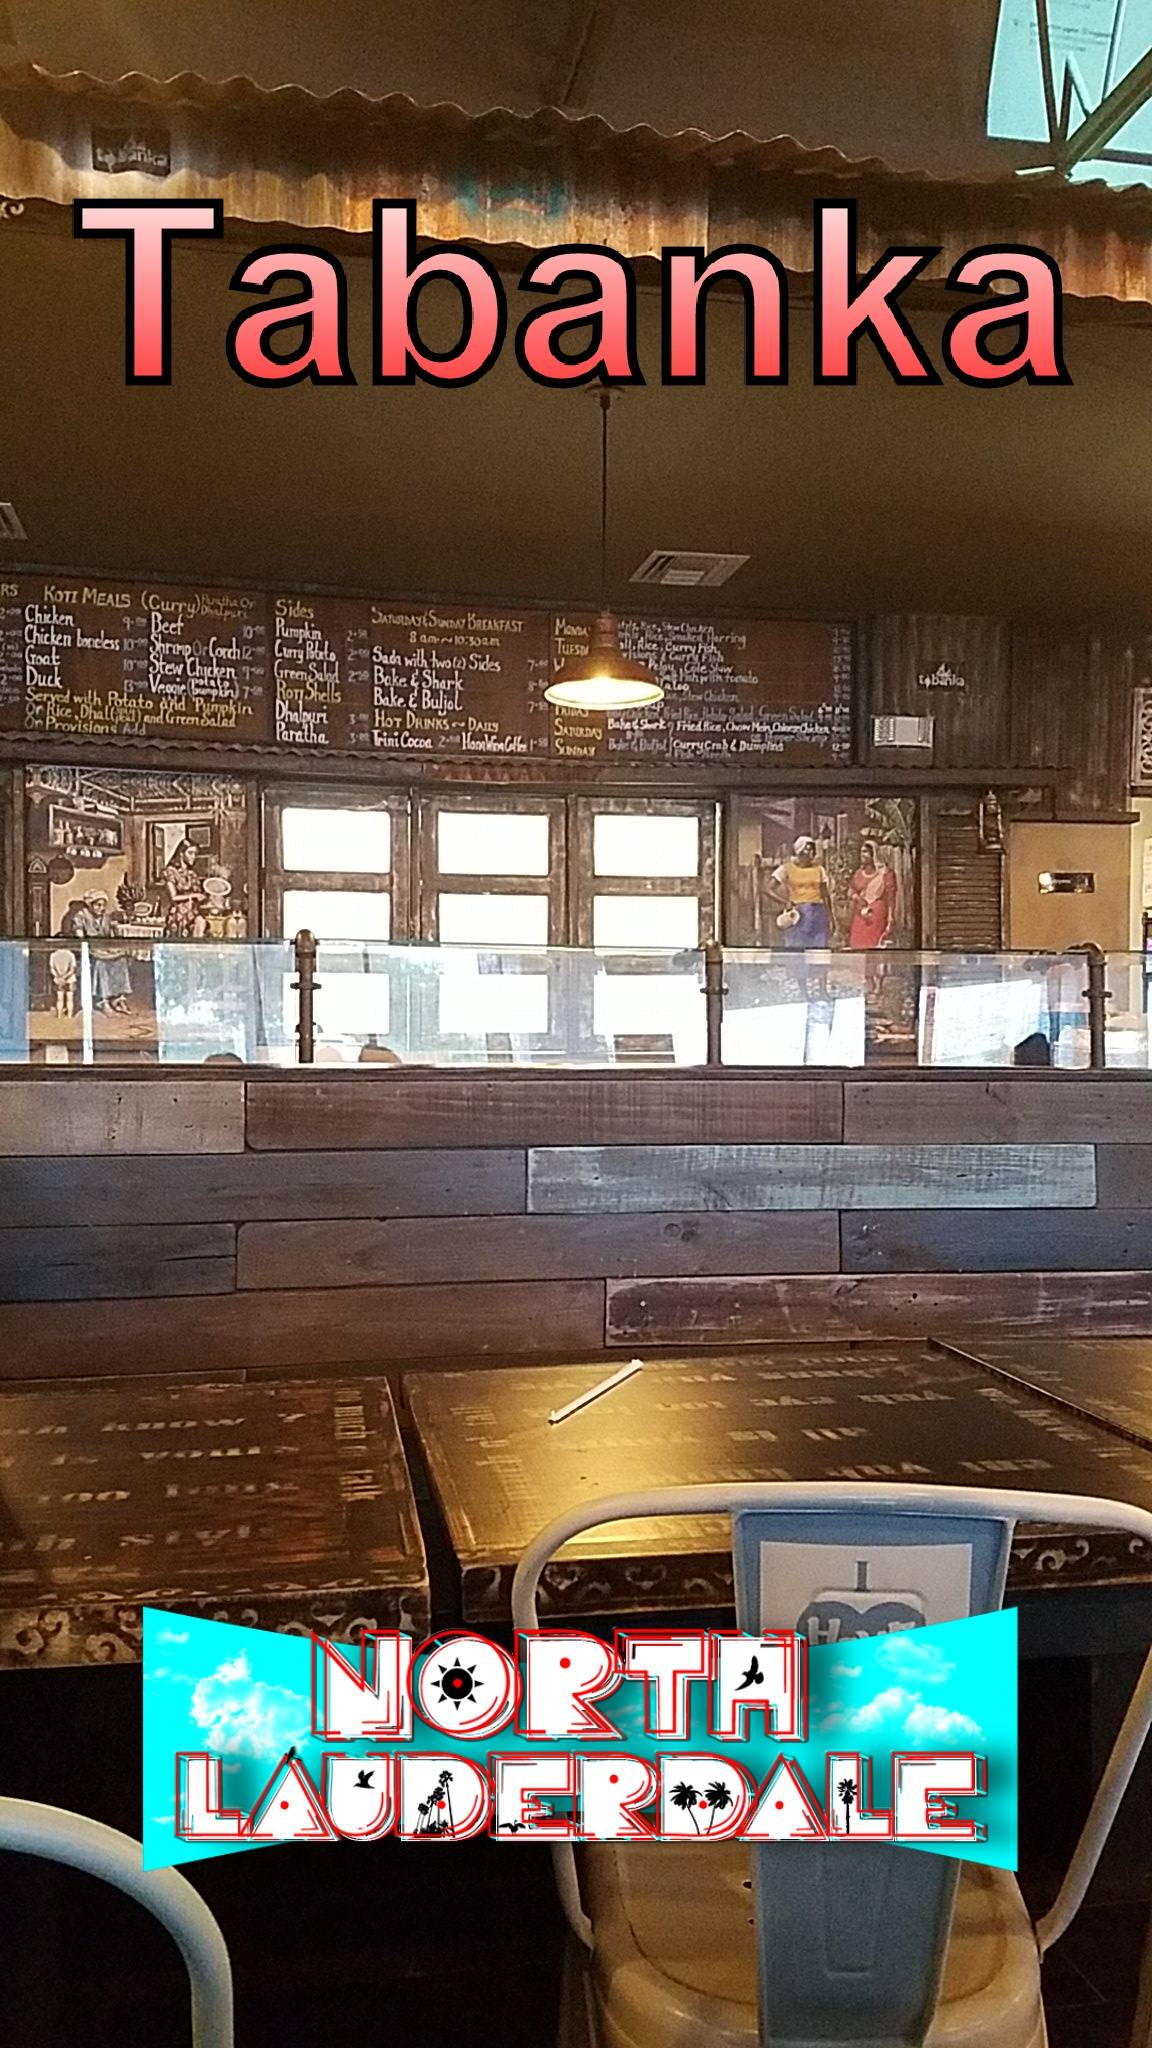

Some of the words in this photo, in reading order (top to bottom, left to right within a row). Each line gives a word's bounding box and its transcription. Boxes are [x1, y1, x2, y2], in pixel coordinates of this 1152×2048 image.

[25, 604, 74, 627] Chicken
[275, 600, 314, 619] Sides
[152, 611, 185, 635] Beef
[276, 617, 321, 644] Pumpkin
[25, 624, 72, 647] Chicken
[149, 633, 192, 661] Shrimp
[25, 645, 60, 665] Goat
[275, 639, 304, 664] Curry
[306, 640, 336, 662] Potato
[372, 646, 401, 665] Sada
[404, 649, 428, 668] with
[468, 653, 501, 672] Sides
[26, 665, 63, 689] Duck
[149, 653, 184, 675] Stew
[187, 657, 237, 680] Chicken
[274, 659, 309, 679] Green
[308, 662, 340, 683] Salad
[421, 669, 464, 690] Shark
[918, 674, 965, 688] tabanka
[25, 686, 71, 704] Served
[73, 688, 102, 706] with
[107, 690, 153, 709] Potato
[160, 694, 186, 711] and
[193, 696, 254, 717] Pumpkin
[305, 681, 342, 703] Shells
[45, 716, 118, 734] Provisions
[122, 723, 147, 736] Add
[166, 711, 199, 726] Green
[201, 711, 236, 728] Salad
[375, 709, 402, 729] HOT
[406, 710, 450, 730] DRINKS
[276, 720, 329, 744] Paratha
[371, 730, 399, 748] Trini
[400, 731, 433, 749] Cocoa
